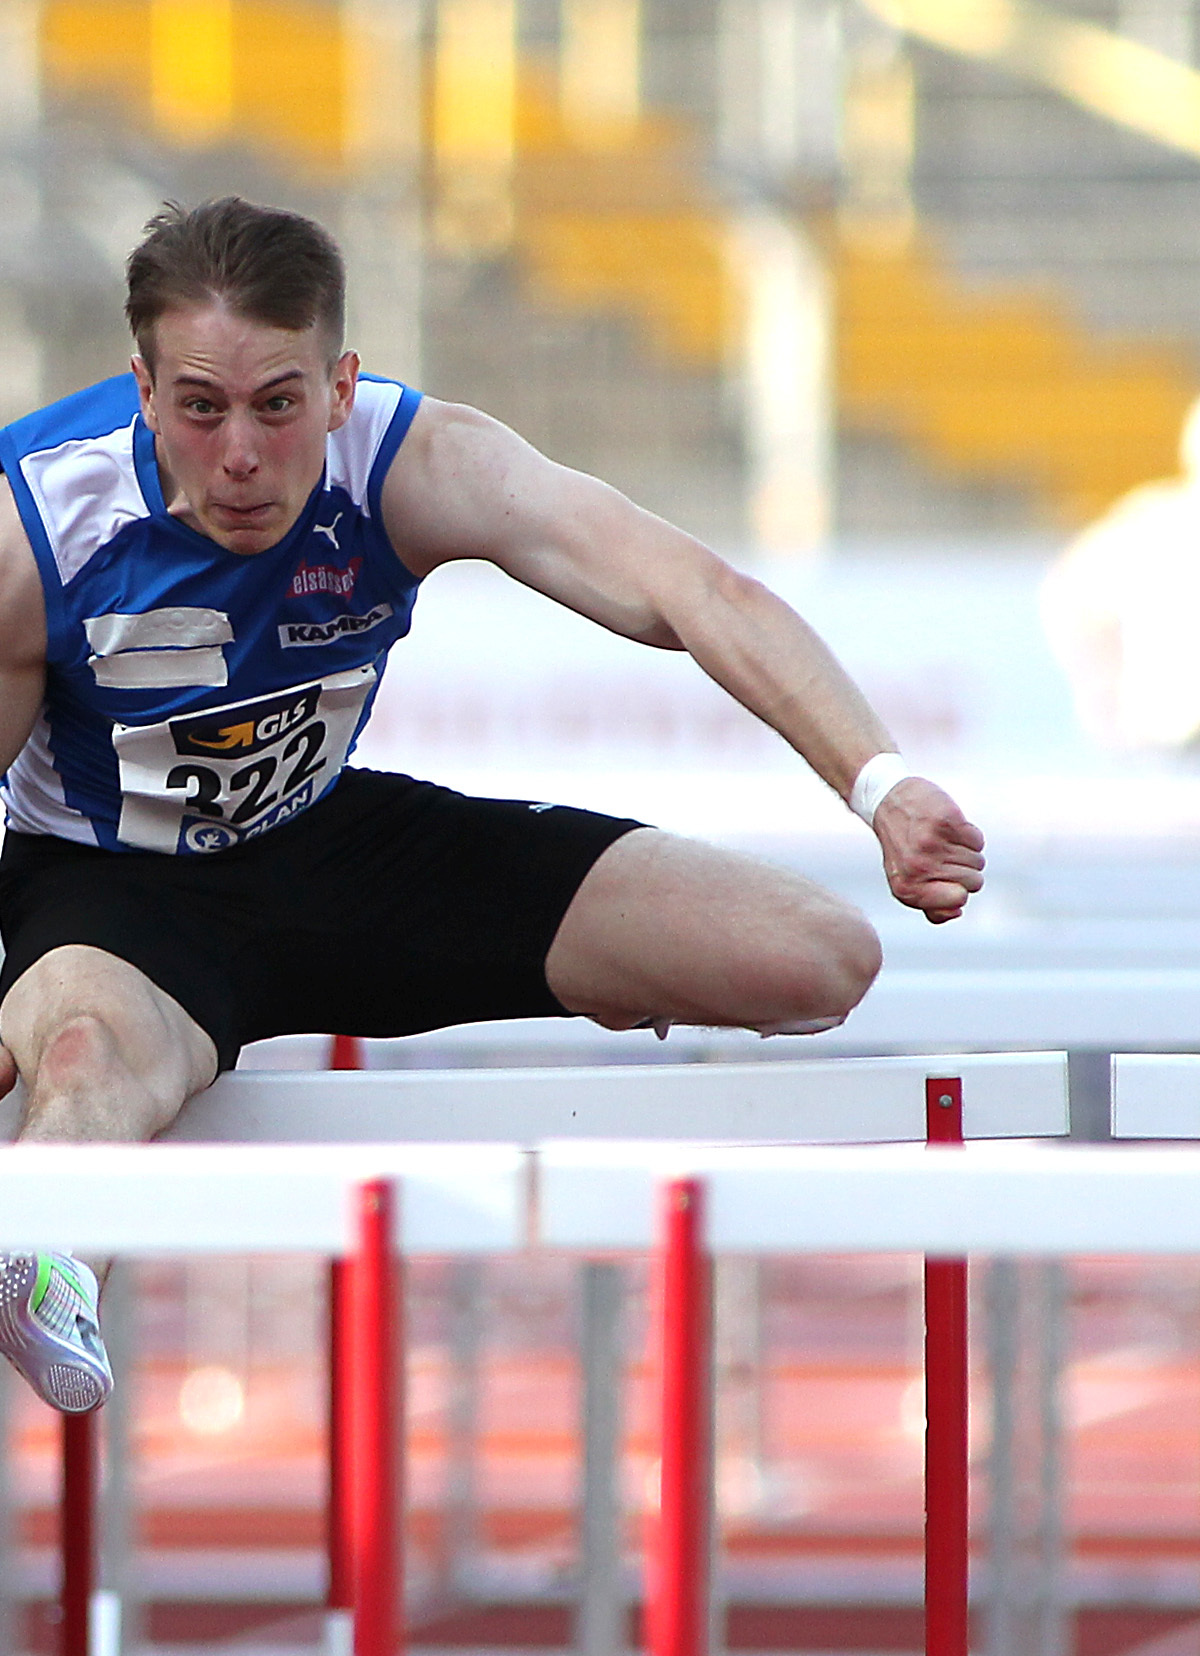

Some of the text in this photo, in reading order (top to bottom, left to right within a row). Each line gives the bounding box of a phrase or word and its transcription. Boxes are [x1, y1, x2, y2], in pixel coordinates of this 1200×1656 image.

[287, 610, 383, 642] KAMPA
[256, 698, 307, 740] GLS
[166, 720, 327, 824] 322
